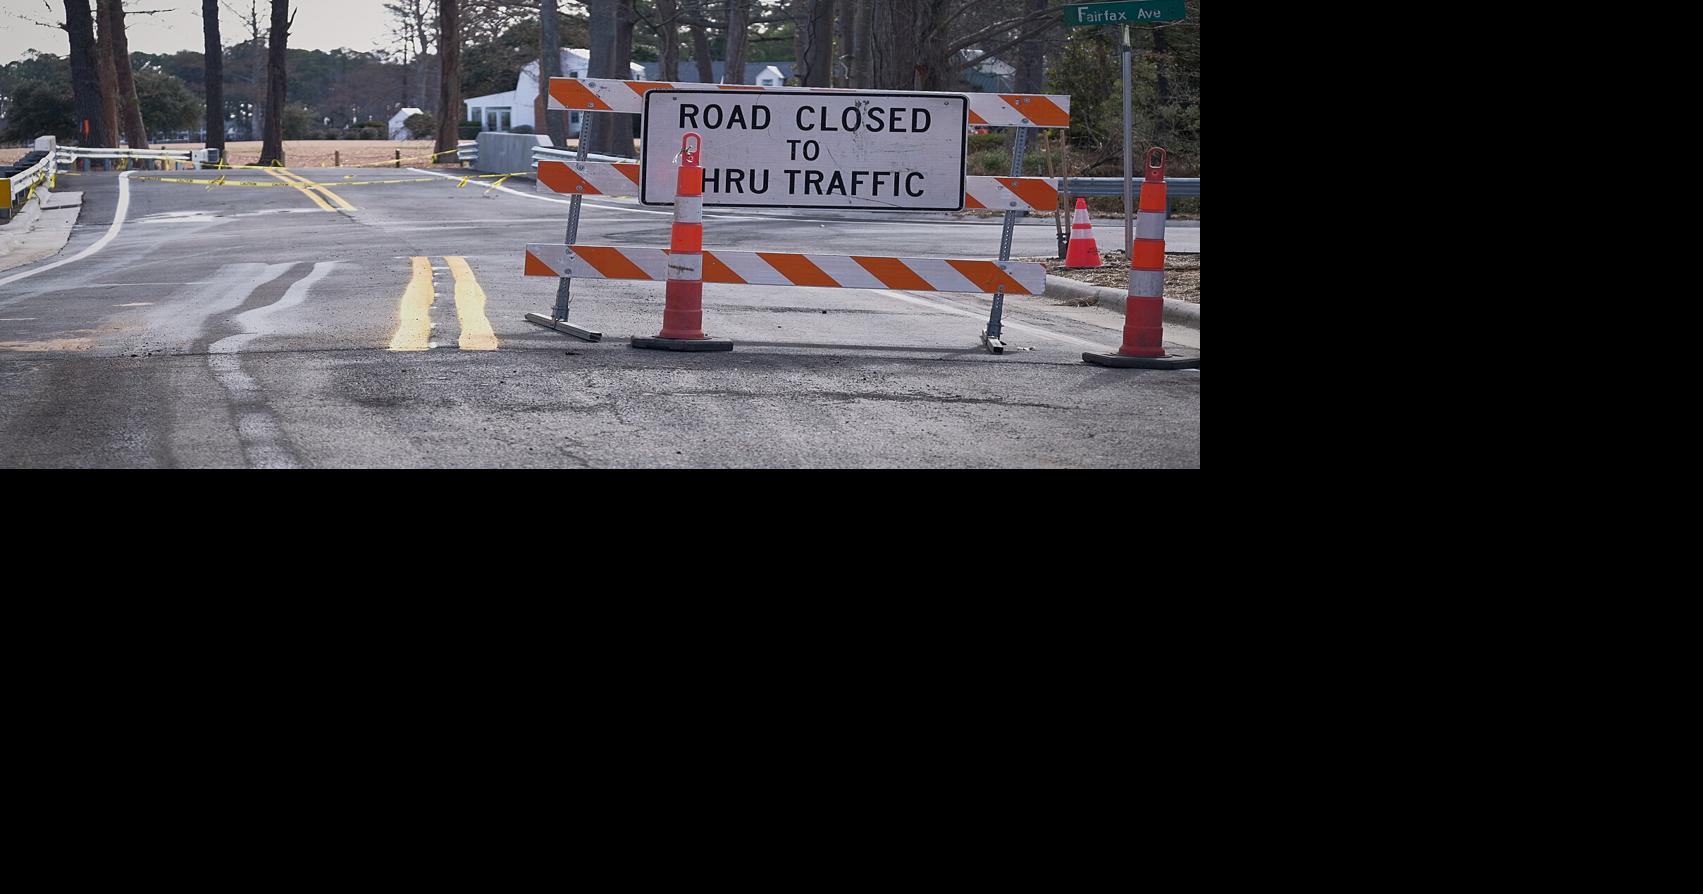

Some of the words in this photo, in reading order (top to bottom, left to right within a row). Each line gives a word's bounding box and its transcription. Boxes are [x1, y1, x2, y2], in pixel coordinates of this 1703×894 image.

[1076, 6, 1127, 22] Fairfax
[1137, 8, 1161, 19] Ave
[678, 103, 771, 130] ROAD
[795, 105, 932, 133] CLOSED
[786, 139, 820, 162] TO
[701, 167, 770, 194] HRU
[783, 168, 925, 198] TRAFFIC
